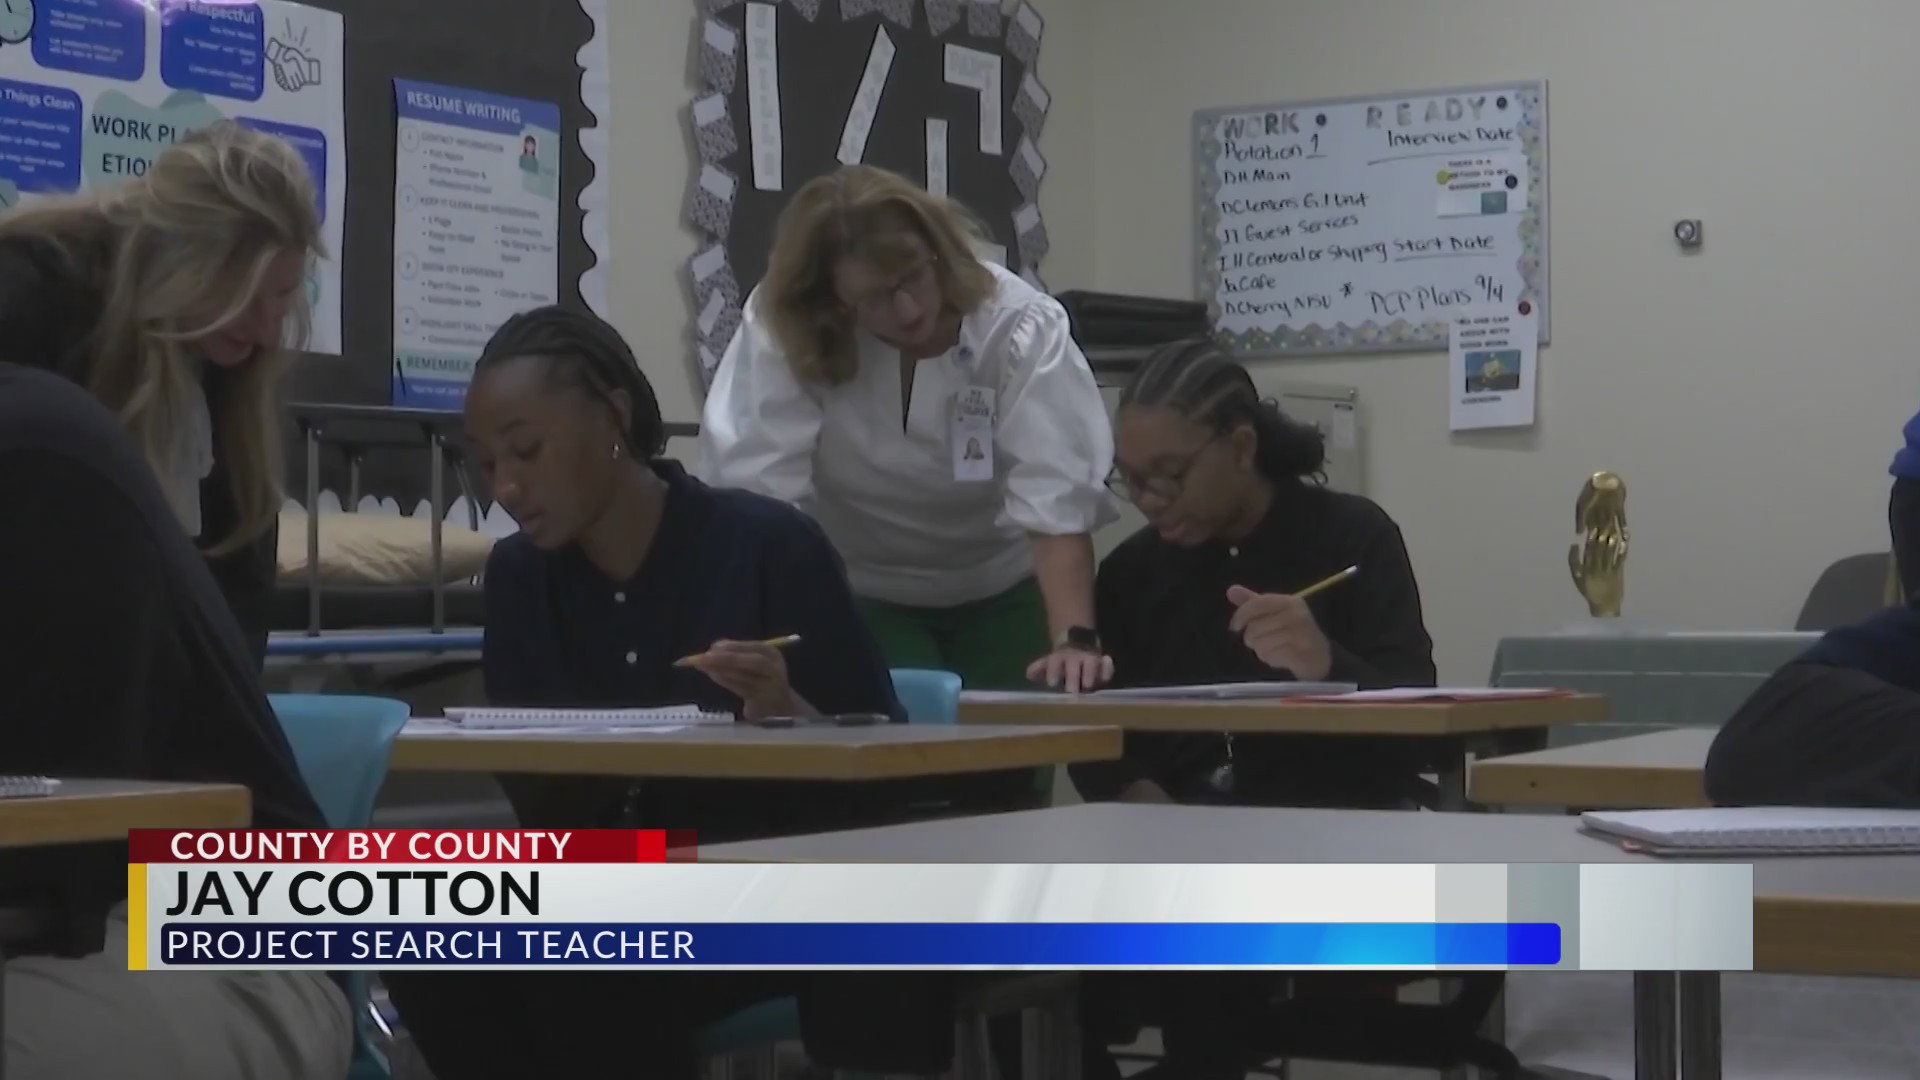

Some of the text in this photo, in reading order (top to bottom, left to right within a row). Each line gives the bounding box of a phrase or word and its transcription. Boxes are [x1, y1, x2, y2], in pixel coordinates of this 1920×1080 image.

[406, 91, 521, 123] RESUME WRITING
[1224, 96, 1486, 139] WORK READY
[92, 114, 152, 142] WORK
[1388, 127, 1514, 147] Interview Date
[1225, 139, 1302, 161] Rotation
[1245, 224, 1290, 242] Guest
[1392, 234, 1495, 252] Start Date
[1414, 285, 1471, 306] Plans
[1475, 274, 1503, 303] 9/4
